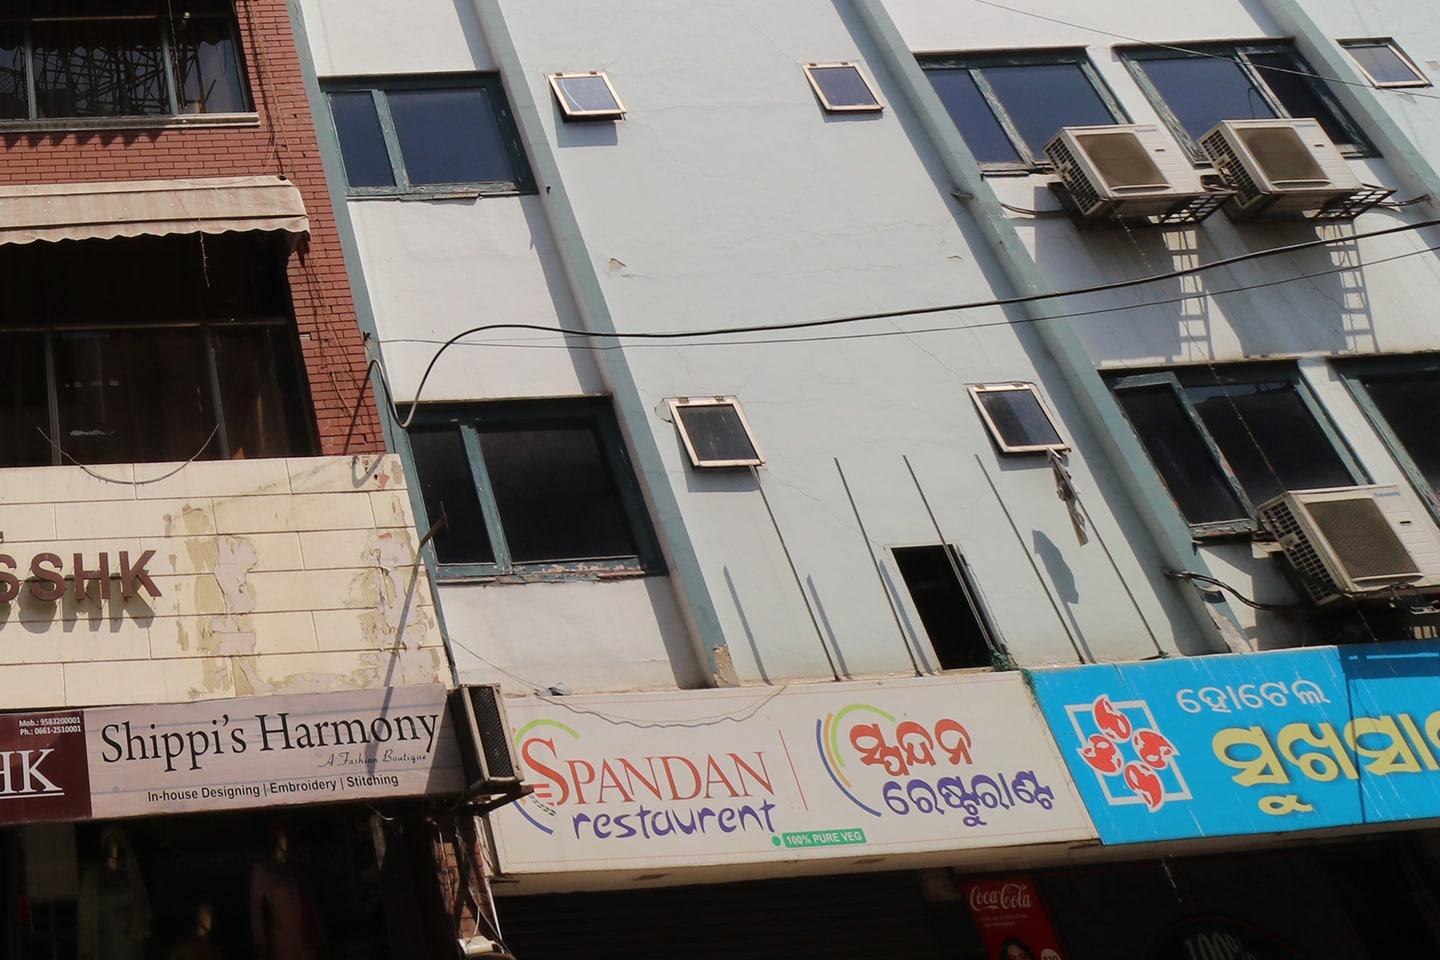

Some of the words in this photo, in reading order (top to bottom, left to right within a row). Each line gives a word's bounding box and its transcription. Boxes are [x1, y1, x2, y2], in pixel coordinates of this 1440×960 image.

[1176, 679, 1331, 714] ହୋଟେଲ
[34, 725, 81, 735] 0661-2510001
[40, 717, 81, 726] 9583200001
[101, 713, 247, 773] Shippi's
[259, 712, 440, 754] Harmony
[318, 753, 335, 768] A
[338, 751, 378, 767] Fashion
[382, 748, 427, 764] Boutique
[148, 789, 199, 802] In-house
[201, 784, 261, 801] Designing
[270, 778, 337, 795] Embroidery
[346, 773, 400, 788] Stitching
[572, 799, 776, 840] restaurent
[786, 834, 812, 845] 100%
[812, 831, 840, 844] PURE
[840, 831, 862, 841] VEG
